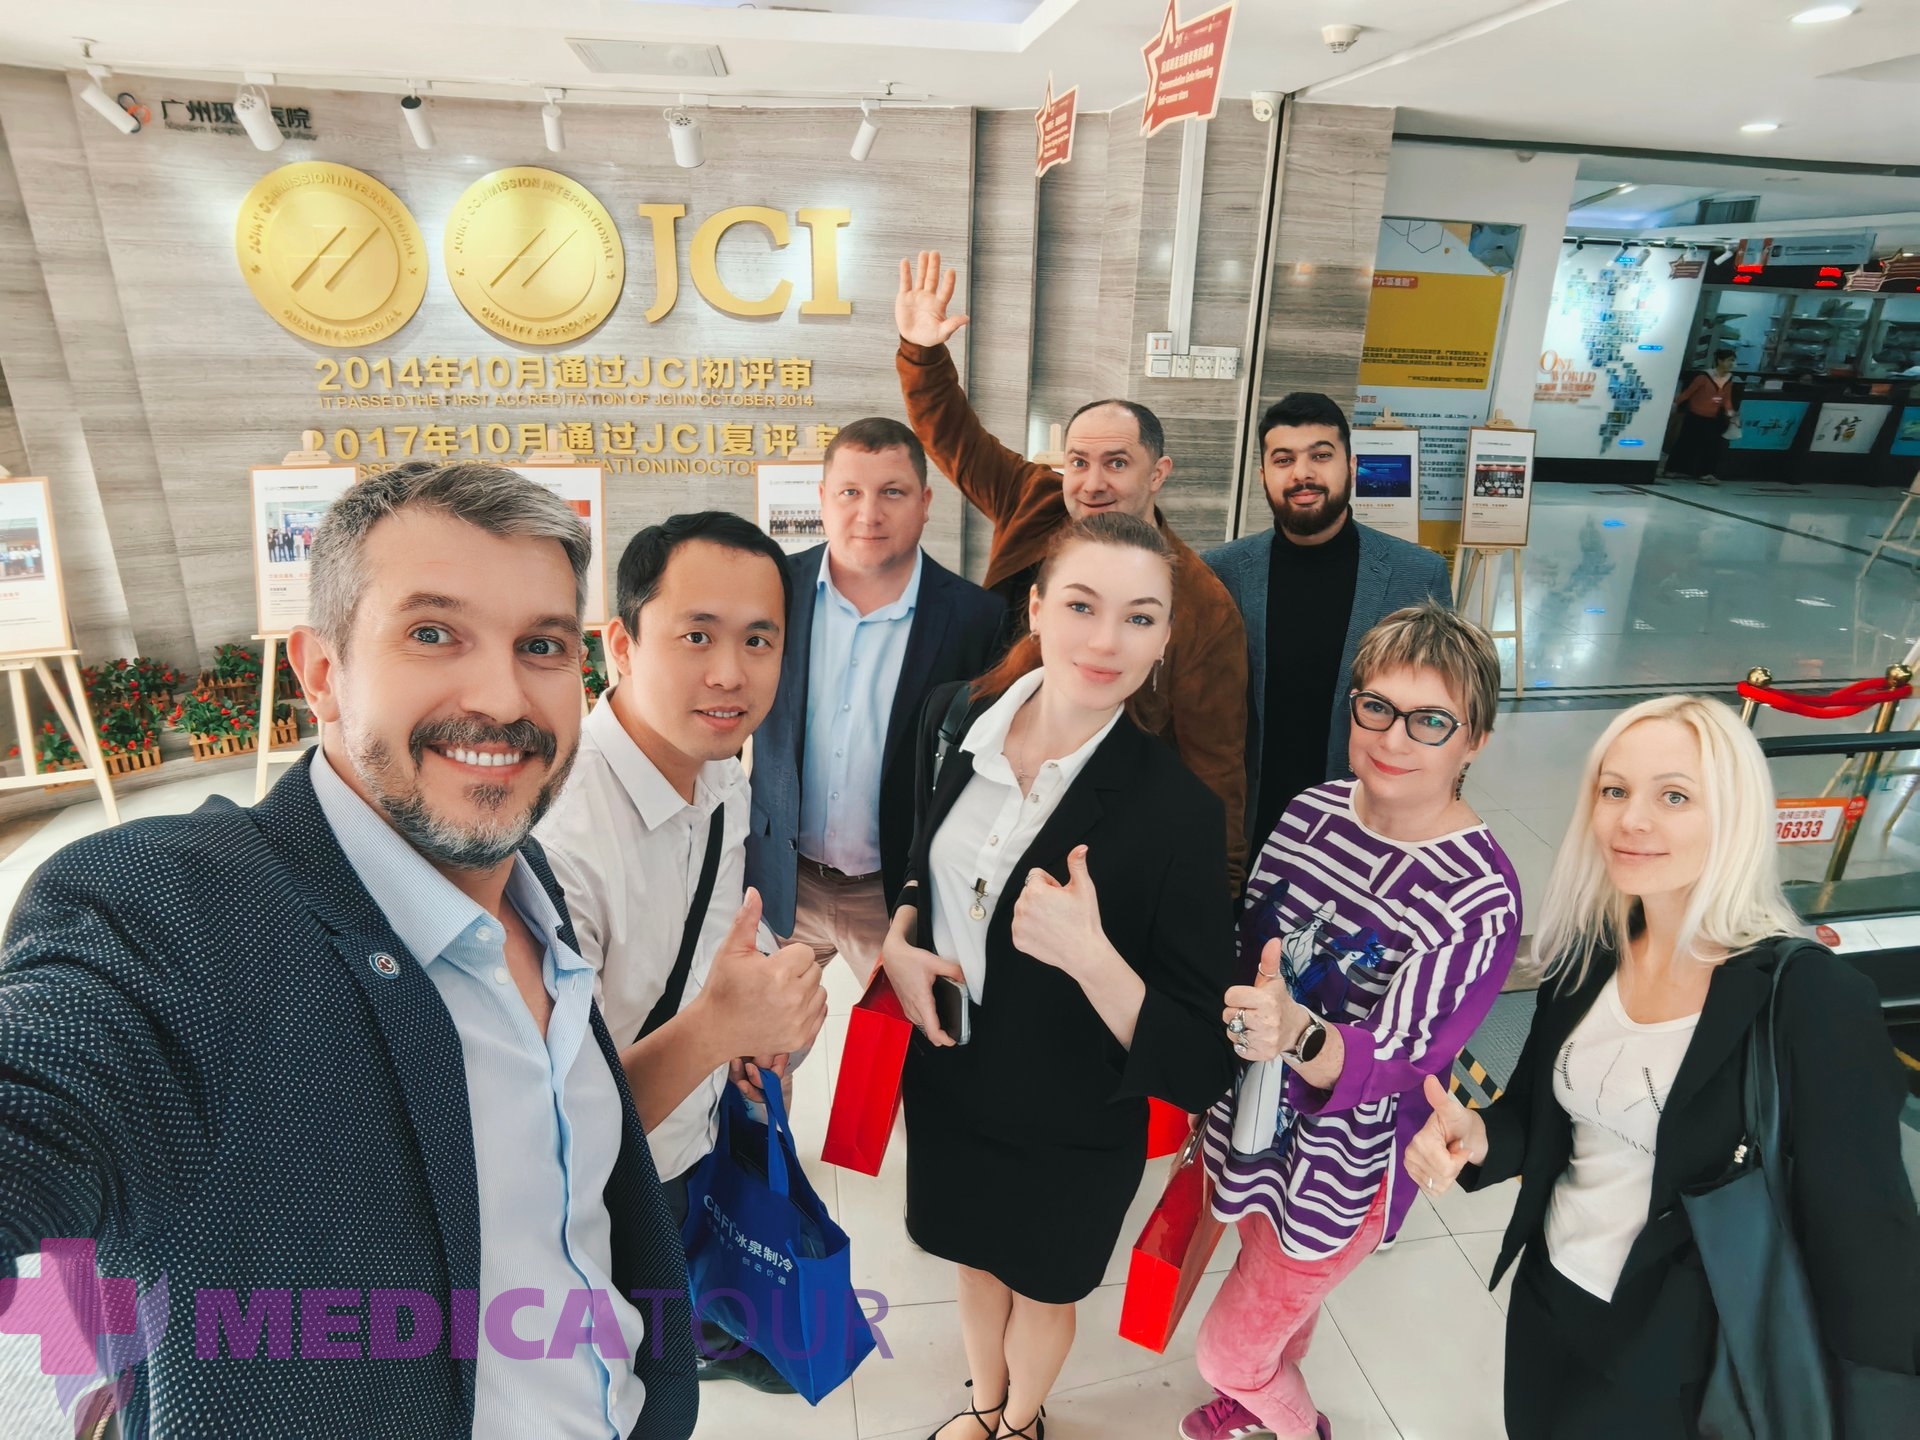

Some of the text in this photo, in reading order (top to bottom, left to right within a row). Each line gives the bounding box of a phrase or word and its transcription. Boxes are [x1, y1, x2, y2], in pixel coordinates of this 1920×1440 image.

[160, 99, 312, 129] 广州现医院
[454, 176, 615, 261] JOINT COMMISSION INTERNATIONAL
[638, 203, 852, 323] JCI
[481, 306, 598, 338] QUALITY APPROVAL
[314, 354, 814, 392] 2014年10月通过JCI初评审
[319, 396, 334, 410] IT
[445, 392, 489, 408] FIRST
[495, 391, 624, 407] ACCREDITATION
[628, 393, 649, 406] OF
[699, 393, 776, 408] OCTOBER
[778, 393, 815, 408] 2014
[735, 1230, 794, 1273] 冰泉制冷
